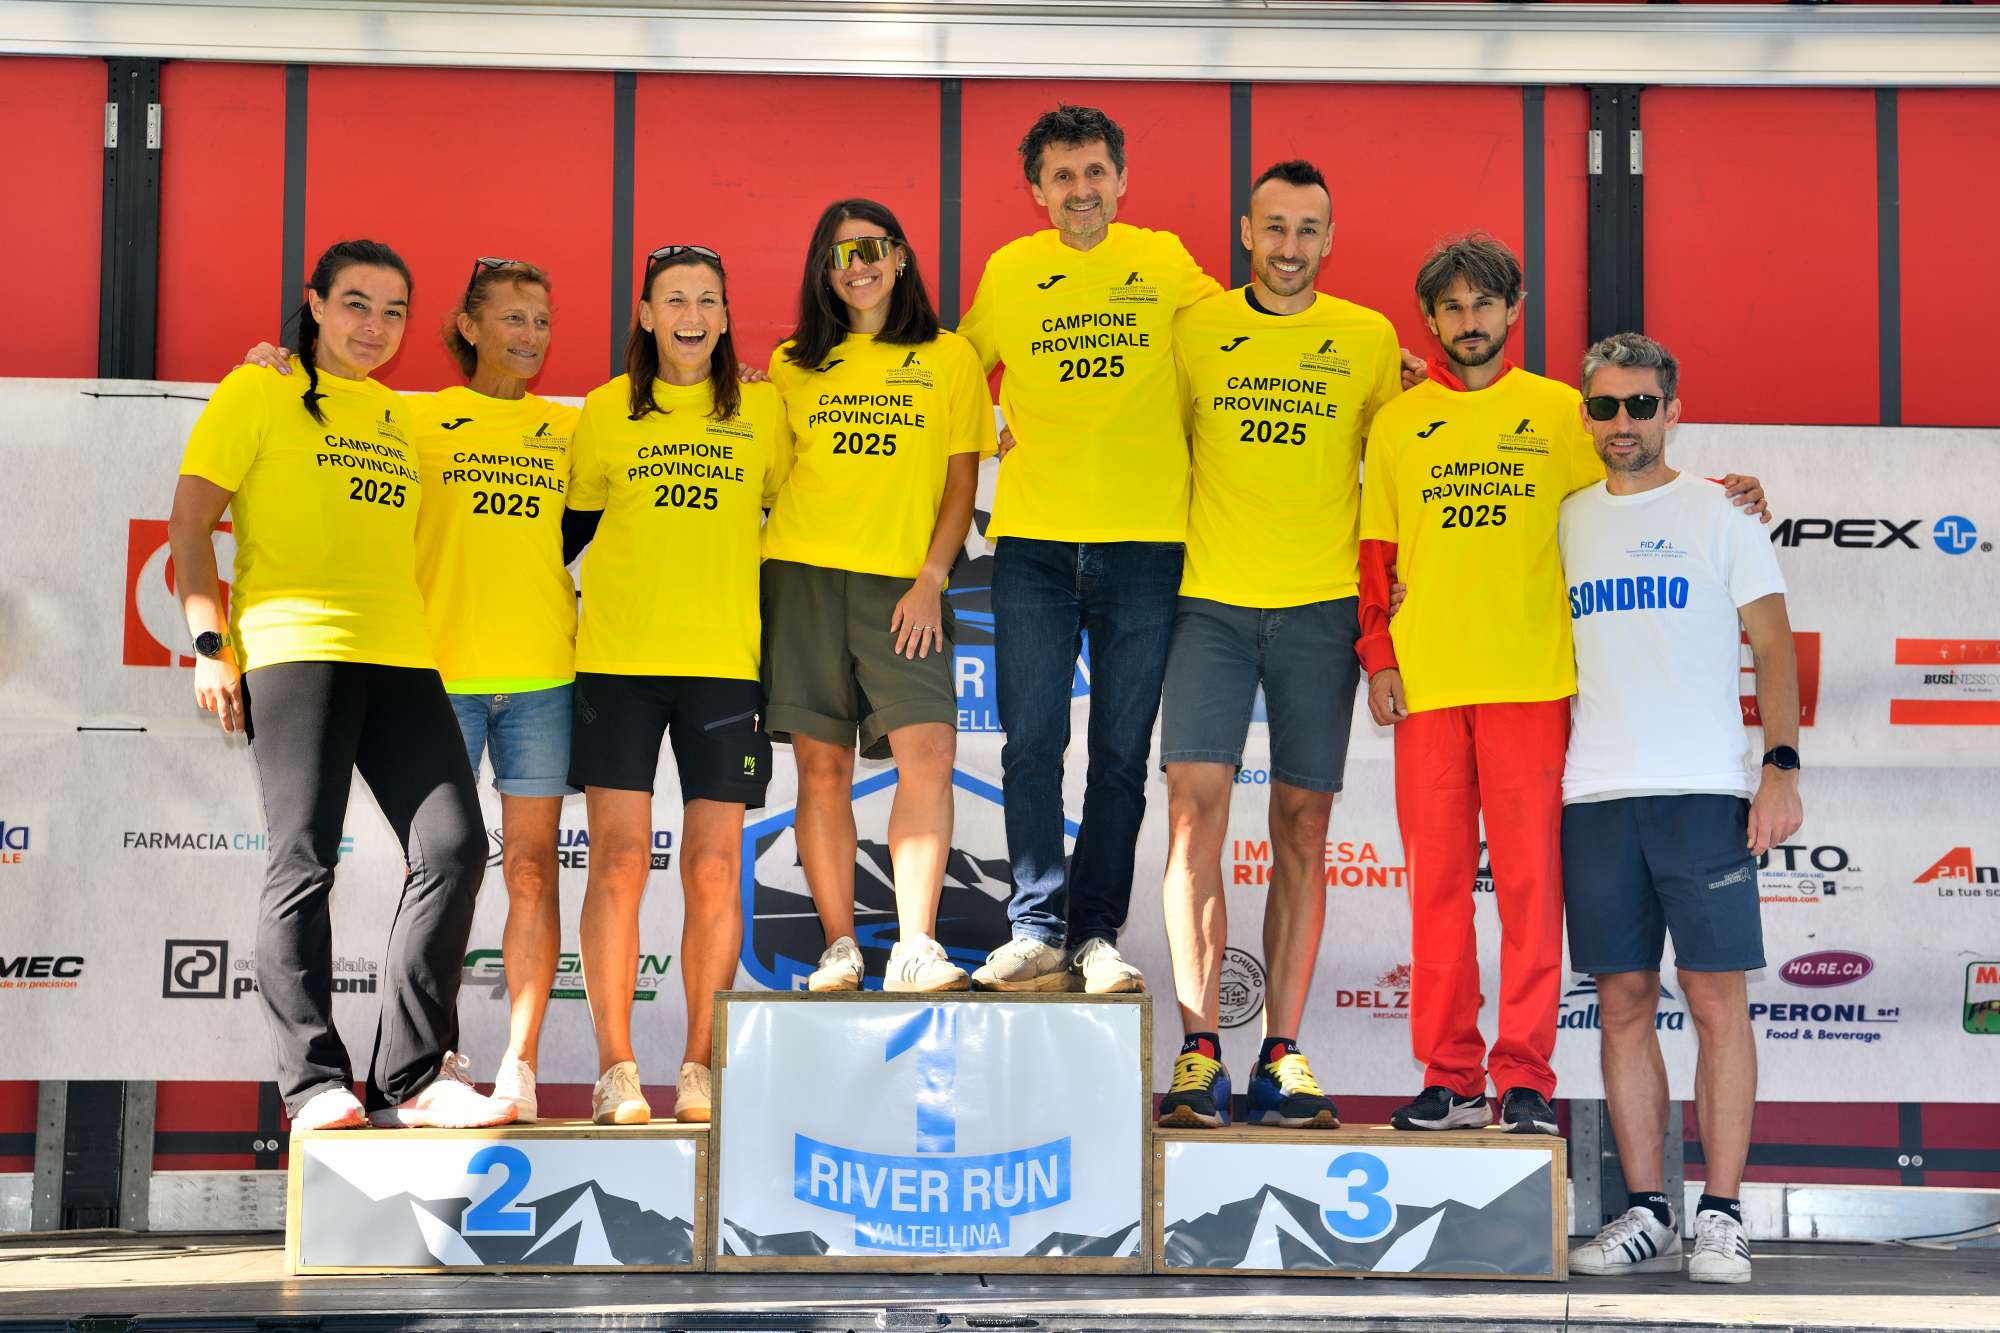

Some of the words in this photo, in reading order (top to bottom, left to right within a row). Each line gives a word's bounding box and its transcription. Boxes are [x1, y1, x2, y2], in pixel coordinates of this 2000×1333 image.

[1042, 312, 1137, 334] CAMPIONE
[1031, 332, 1150, 356] PROVINCIALE
[1059, 355, 1125, 383] 2025
[1227, 376, 1327, 395] CAMPIONE
[818, 394, 914, 407] CAMPIONE
[1213, 397, 1338, 419] PROVINCIALE
[809, 410, 925, 429] PROVINCIALE
[832, 431, 897, 457] 2025
[1240, 419, 1307, 446] 2025
[324, 435, 408, 462] CAMPIONE
[637, 443, 734, 460] CAMPIONE
[316, 453, 421, 484] PROVINCIALE
[453, 452, 555, 471] CAMPIONE
[627, 462, 745, 483] PROVINCIALE
[1430, 461, 1525, 479] CAMPIONE
[349, 476, 407, 509] 2025
[442, 468, 565, 494] PROVINCIALE
[654, 484, 718, 511] 2025
[1421, 482, 1536, 504] PROVINCIALE
[472, 491, 541, 519] 2025
[1441, 505, 1507, 529] 2025
[1570, 575, 1690, 620] SONDRIO
[123, 832, 229, 850] FARMACIA
[1234, 840, 1379, 863] IMESA
[1938, 887, 1953, 897] La
[1958, 888, 1980, 897] tua
[1230, 954, 1263, 988] CHIURO
[1788, 962, 1863, 976] HO.RE.CA
[17, 980, 27, 988] in
[29, 980, 78, 990] precision
[1336, 990, 1389, 1008] DEL
[1749, 1003, 1867, 1022] PERONI
[1877, 1007, 1899, 1016] srl
[1766, 1028, 1799, 1040] Food
[1803, 1029, 1813, 1040] &
[1817, 1029, 1881, 1043] Beverage
[886, 1008, 956, 1153] 1
[465, 1145, 535, 1233] 2
[811, 1153, 949, 1214] RIVER
[962, 1154, 1058, 1213] RUN
[1325, 1151, 1393, 1239] 3
[866, 1220, 1002, 1248] VALTELLINA
